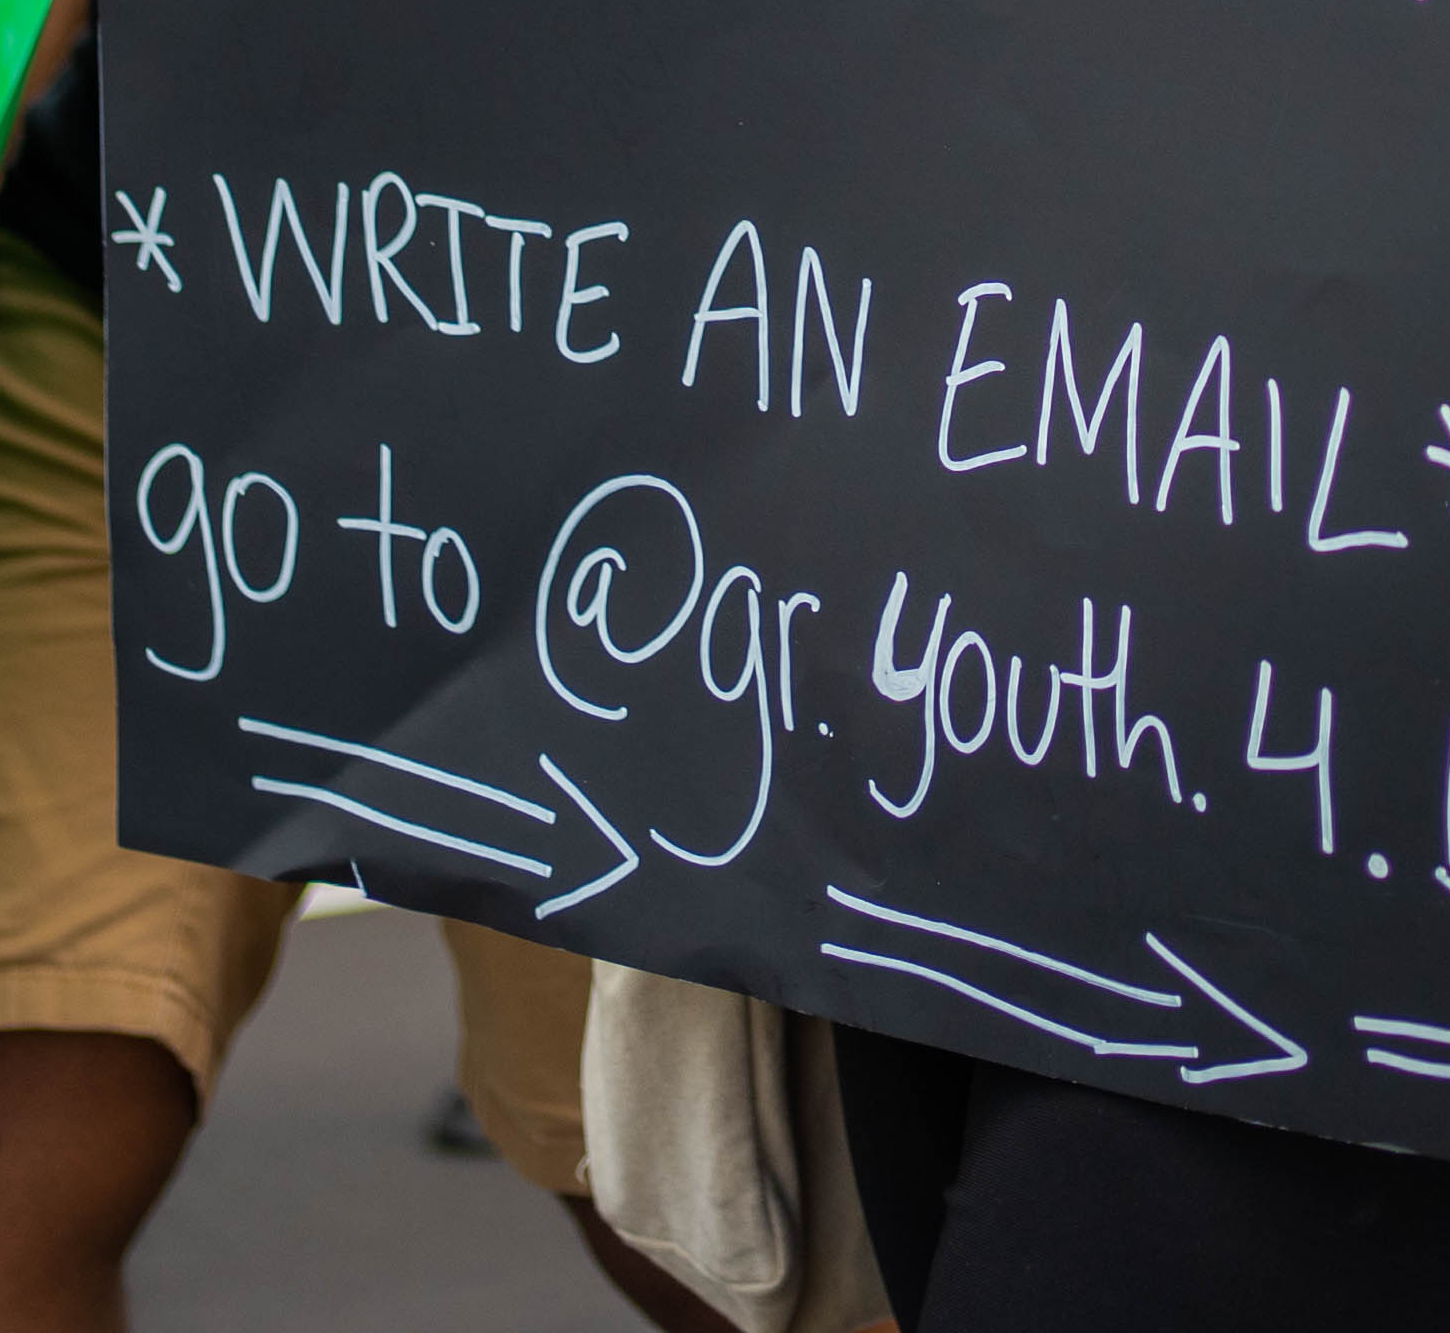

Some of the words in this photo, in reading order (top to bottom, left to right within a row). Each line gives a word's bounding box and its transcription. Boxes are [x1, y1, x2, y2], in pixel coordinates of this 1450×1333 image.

[213, 174, 629, 364] WRITE
[682, 220, 871, 418] AN
[938, 282, 1409, 552] EMAIL
[138, 445, 297, 680] go
[337, 444, 479, 633] to
